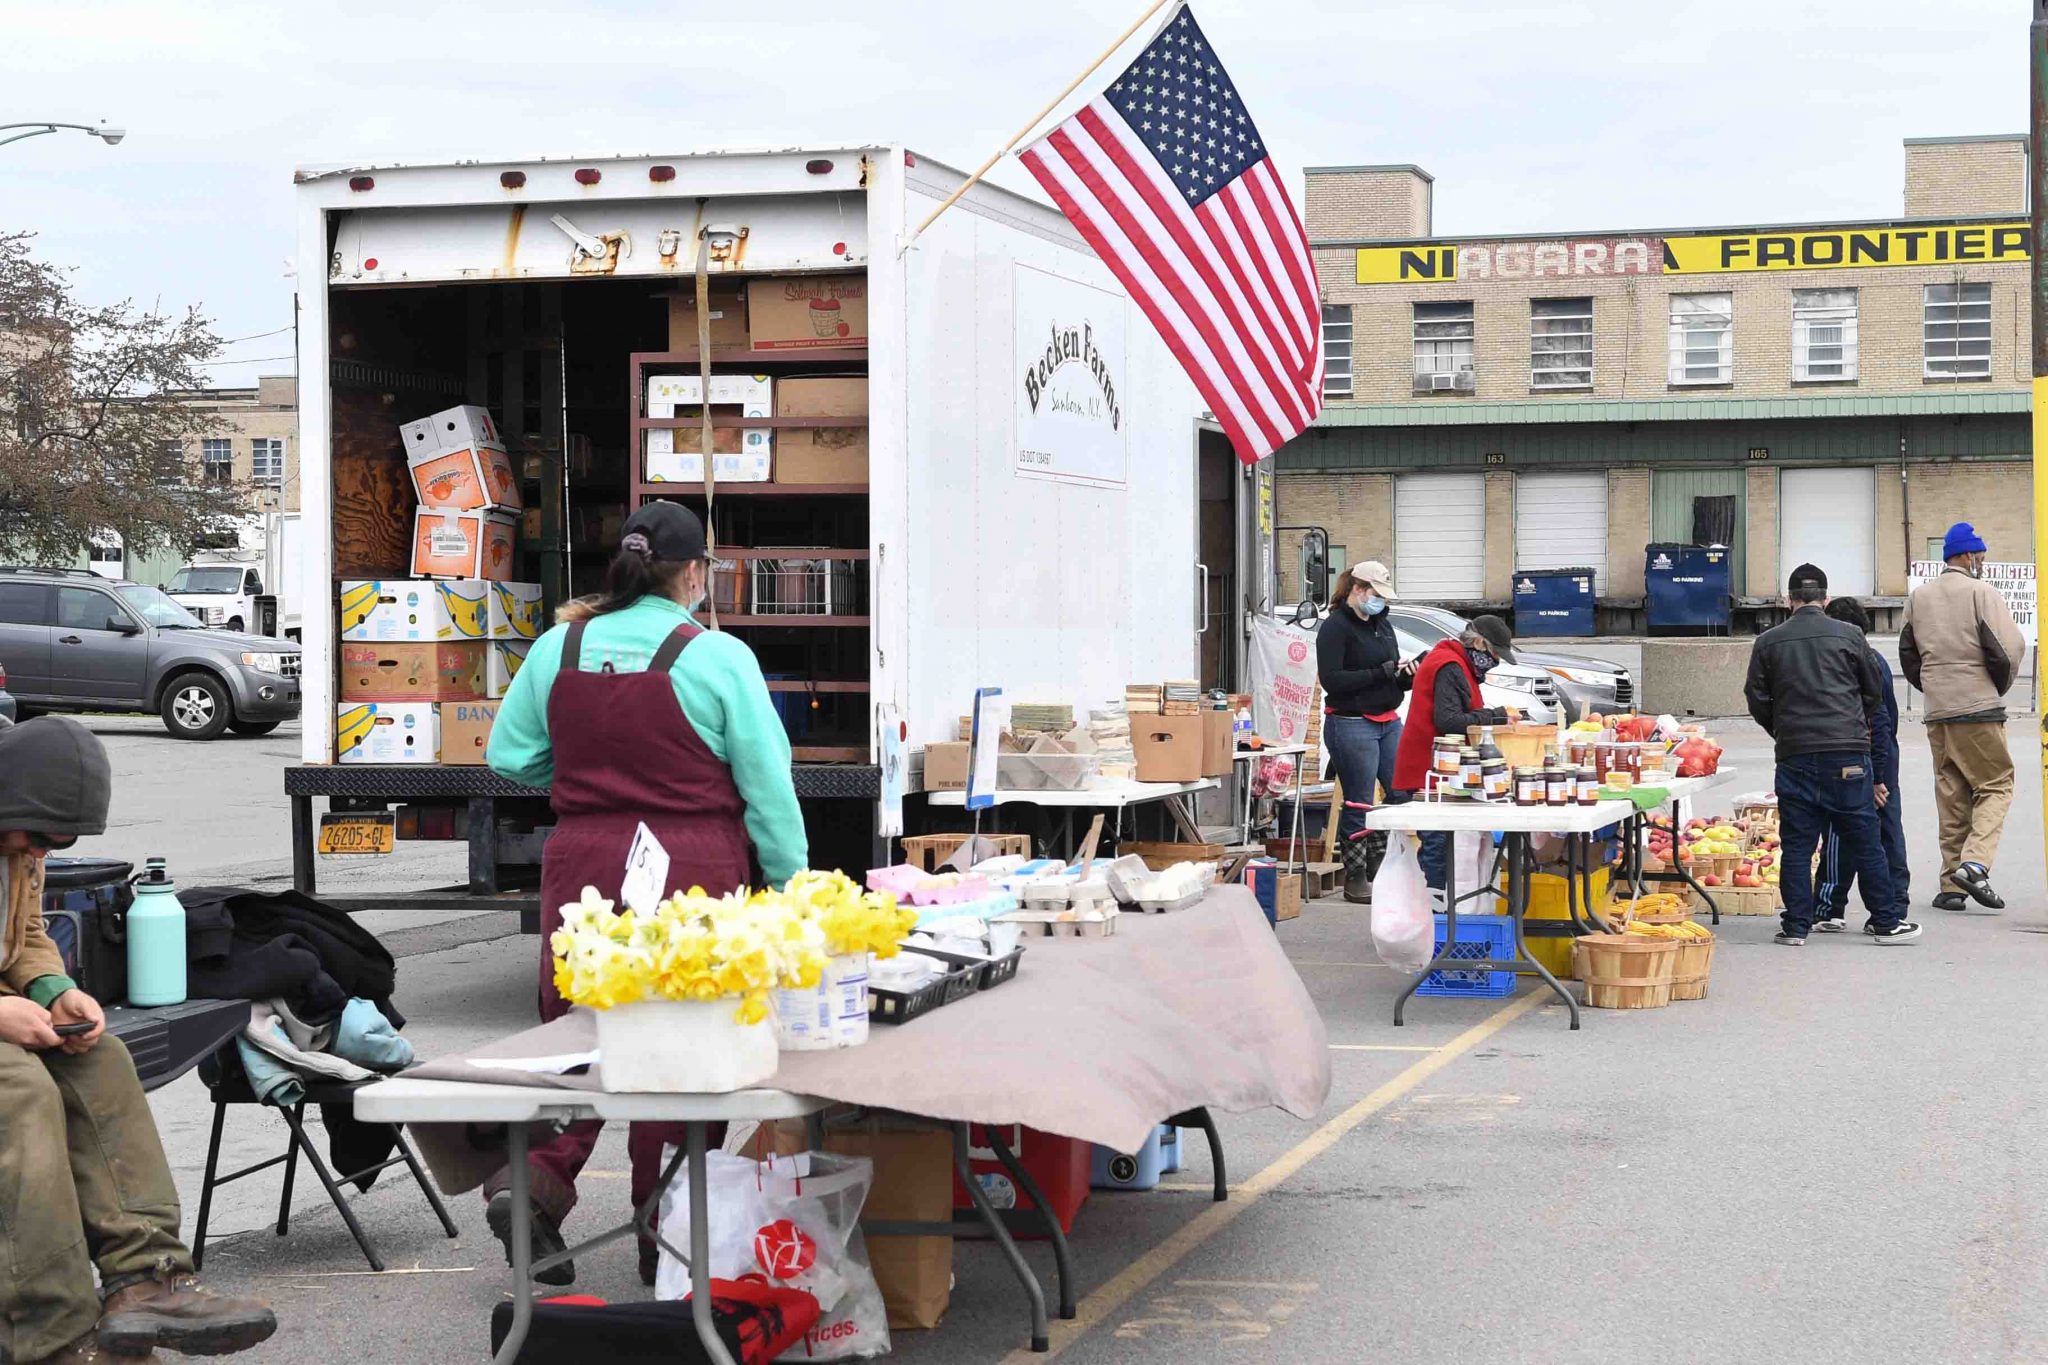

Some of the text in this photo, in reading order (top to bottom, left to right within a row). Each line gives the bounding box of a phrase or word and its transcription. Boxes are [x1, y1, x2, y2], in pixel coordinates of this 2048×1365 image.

[1721, 226, 2031, 268] FRONTIER
[1025, 322, 1120, 432] Becken Farms
[1487, 454, 1504, 464] 163
[1750, 449, 1767, 459] 165
[1914, 562, 2035, 579] PARK STRICTED
[2017, 581, 2027, 590] OF
[2013, 592, 2035, 601] MARKET
[456, 706, 494, 721] BAN
